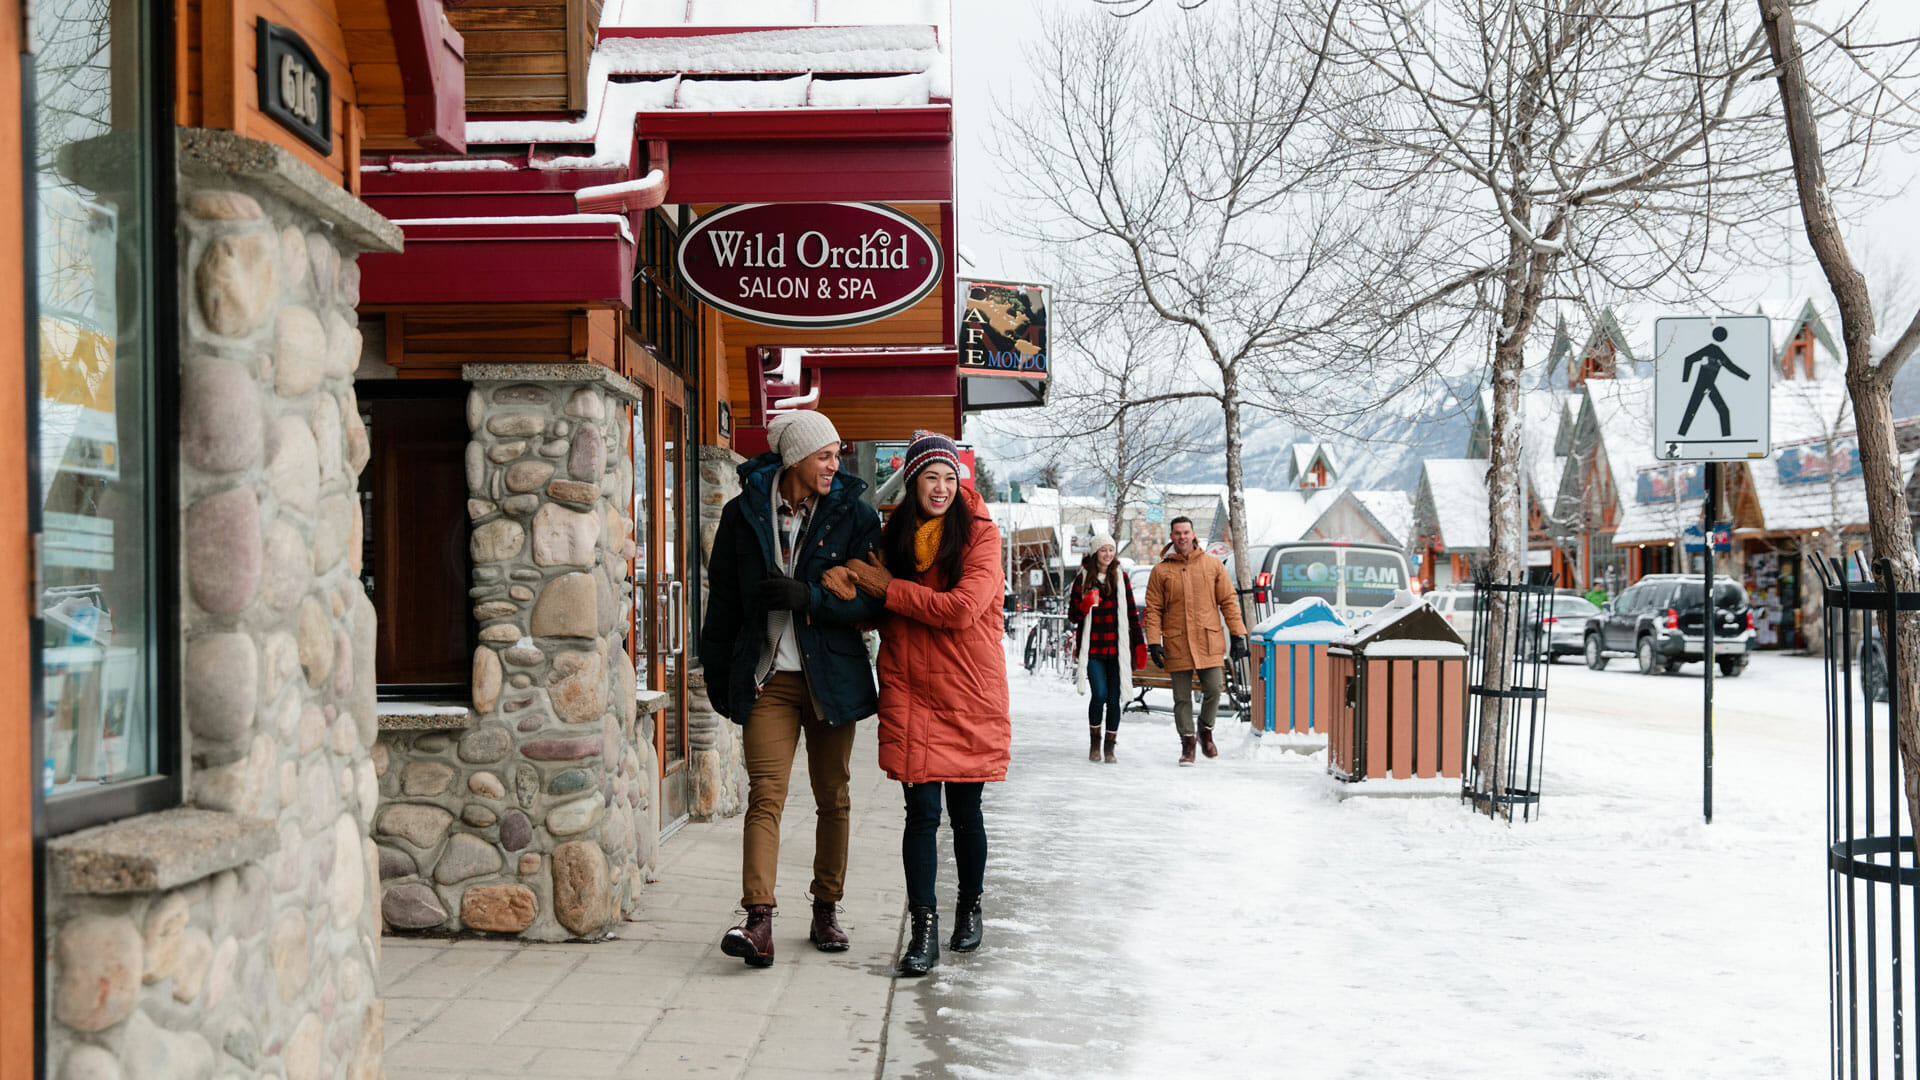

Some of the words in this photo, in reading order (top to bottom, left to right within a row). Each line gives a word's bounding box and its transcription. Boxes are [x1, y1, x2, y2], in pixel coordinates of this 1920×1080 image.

[281, 53, 318, 125] 616
[707, 231, 787, 268] Wild
[796, 228, 910, 270] Orchid
[739, 276, 809, 299] SALON
[817, 277, 831, 299] &
[838, 277, 876, 300] SPA
[988, 350, 1047, 370] MONDO
